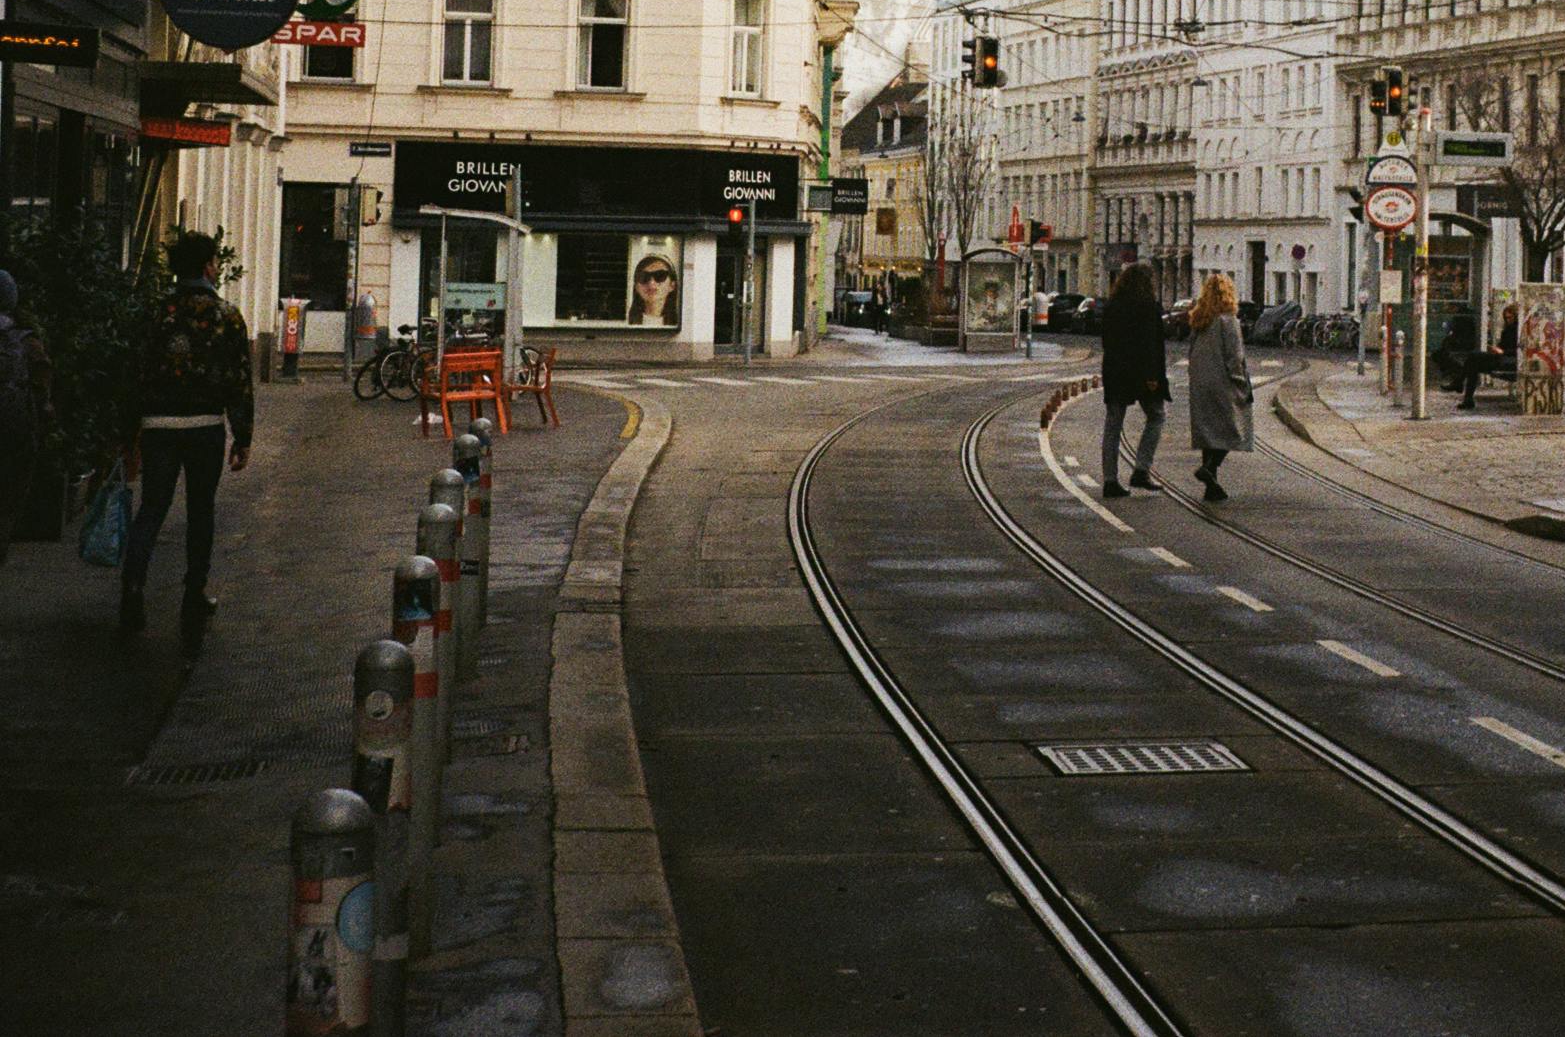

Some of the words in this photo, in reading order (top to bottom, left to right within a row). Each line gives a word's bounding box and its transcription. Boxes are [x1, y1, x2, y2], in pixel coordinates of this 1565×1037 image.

[274, 24, 362, 43] SPAR
[456, 161, 521, 175] BRILLEN
[728, 169, 771, 183] BRILLEN
[448, 179, 507, 193] GIOVAN
[837, 189, 864, 197] BRILLEN
[723, 186, 776, 201] GIOVANNI
